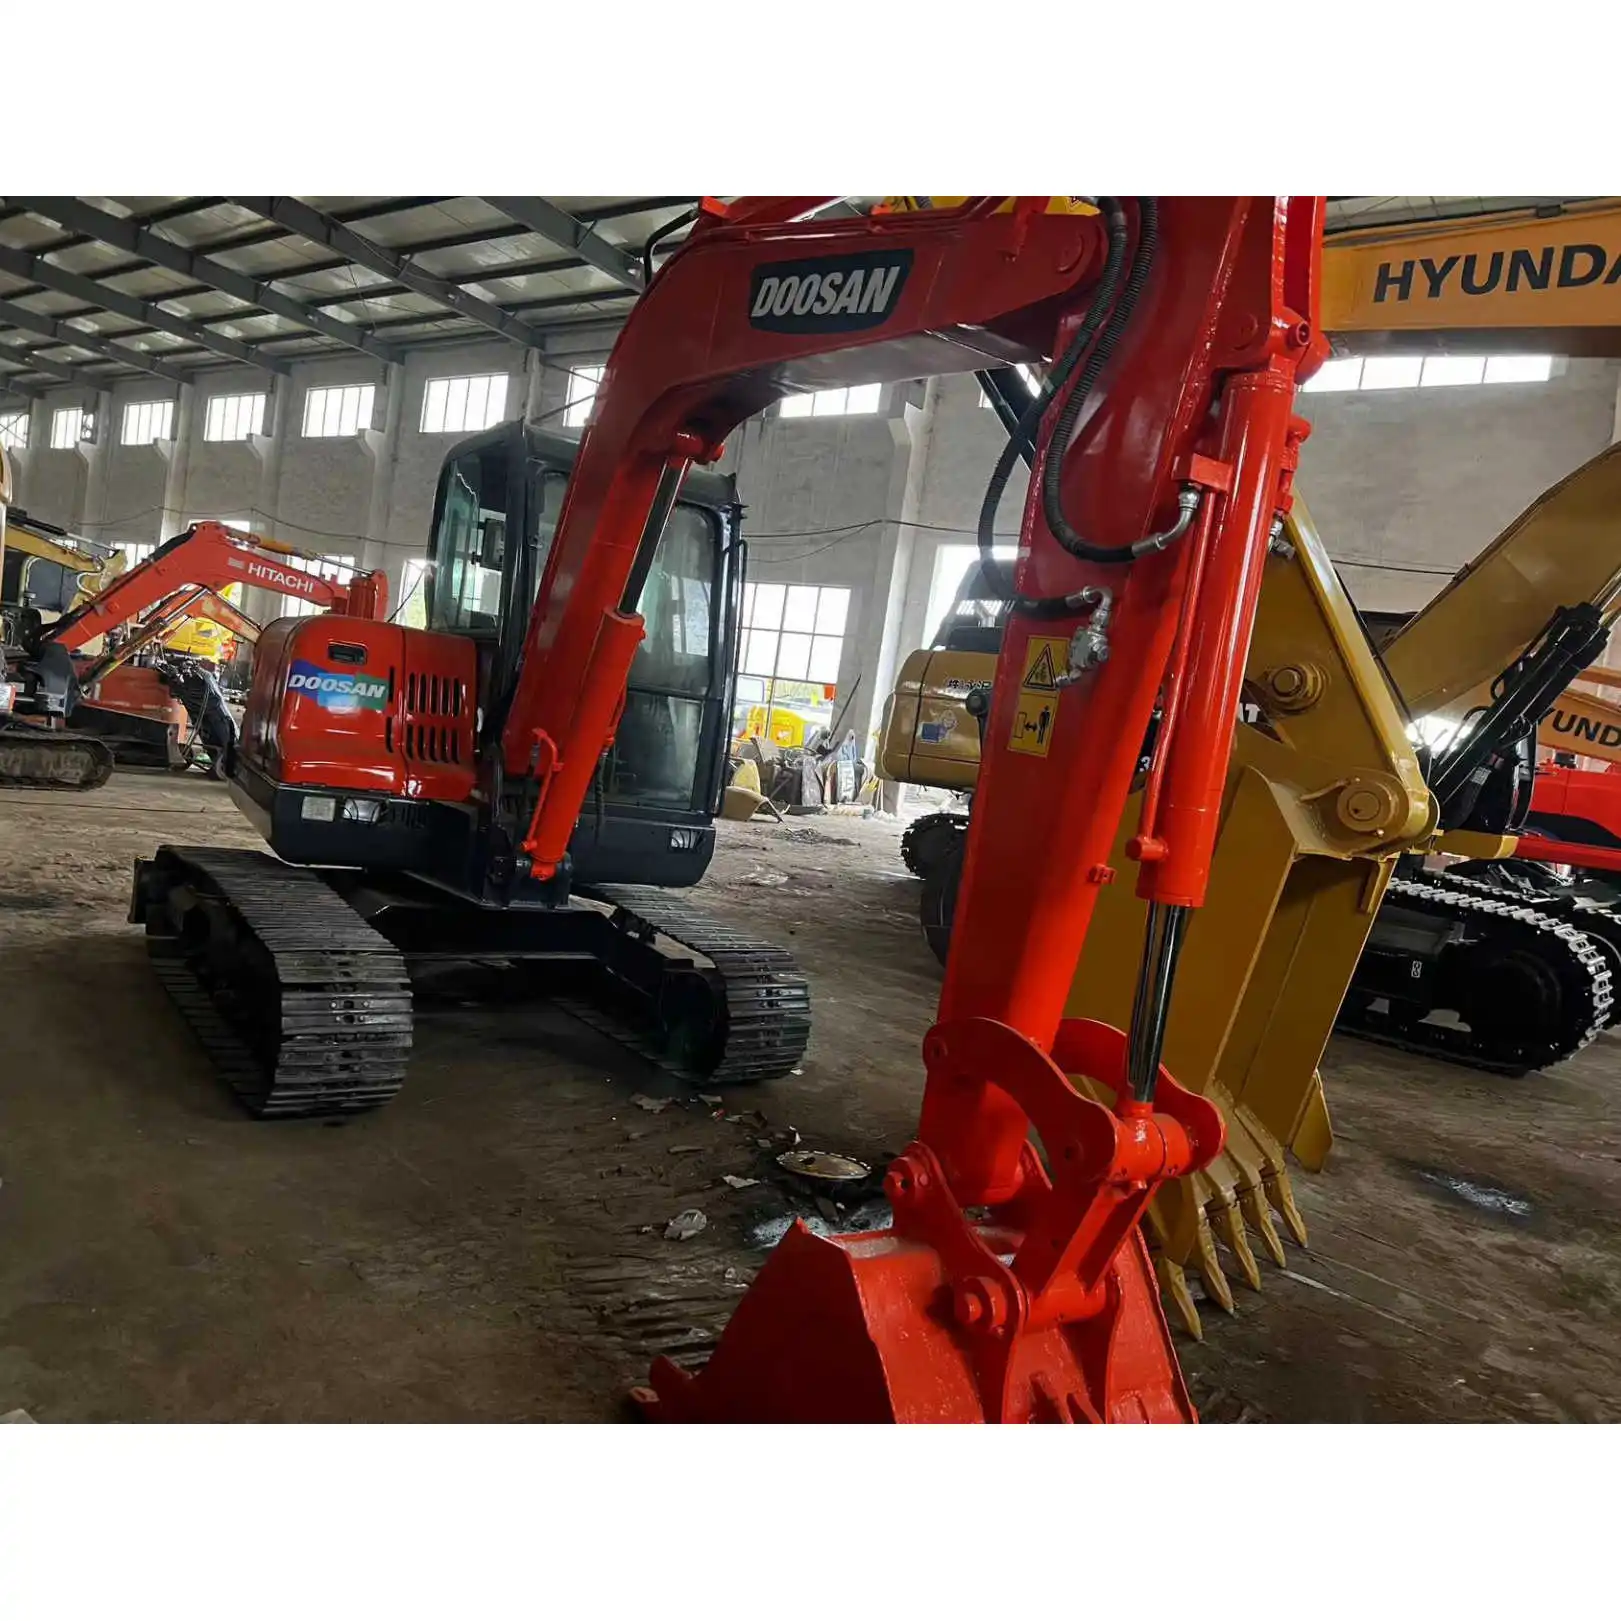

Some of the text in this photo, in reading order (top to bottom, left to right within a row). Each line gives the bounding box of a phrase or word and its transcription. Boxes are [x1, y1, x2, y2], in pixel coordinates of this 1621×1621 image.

[751, 266, 900, 317] DOOSAN
[248, 562, 314, 593] HITACHI
[288, 674, 385, 698] DOOSAN
